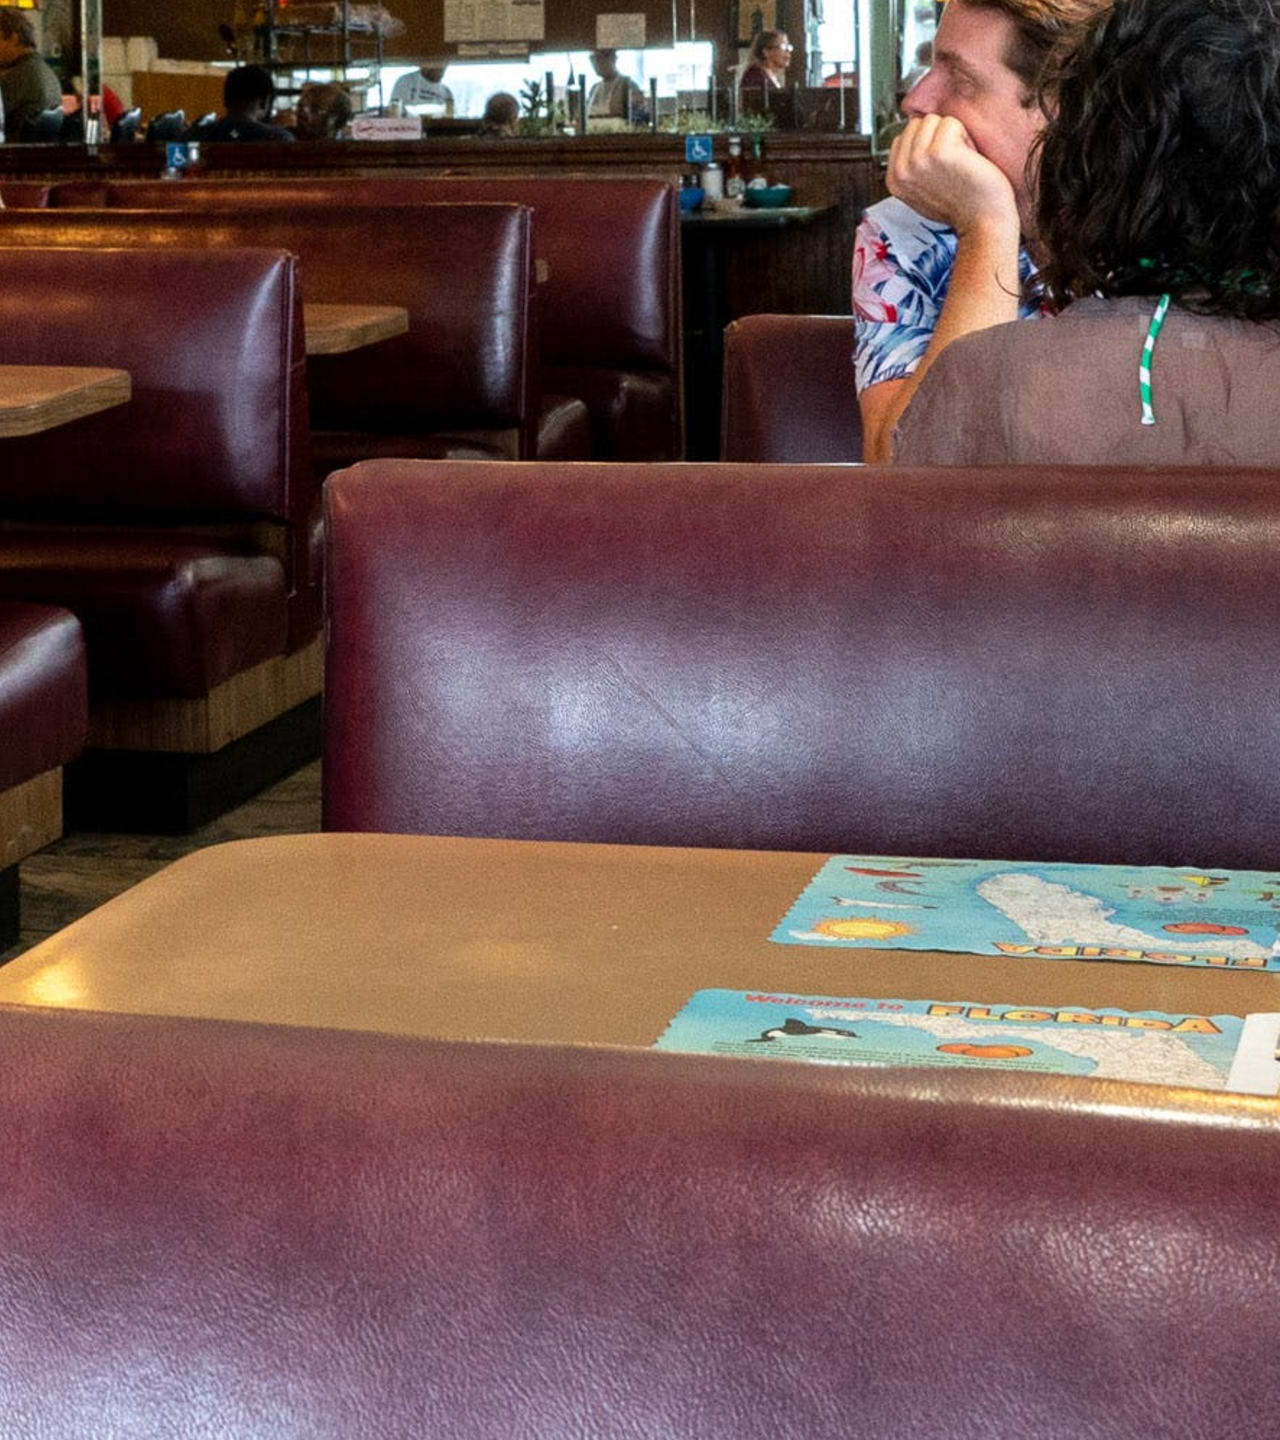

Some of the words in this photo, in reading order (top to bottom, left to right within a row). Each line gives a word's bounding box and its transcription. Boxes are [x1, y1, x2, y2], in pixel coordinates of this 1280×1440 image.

[993, 941, 1268, 968] FLORIDA
[745, 993, 866, 1009] Welcome
[927, 1004, 1222, 1034] FLORIDA
